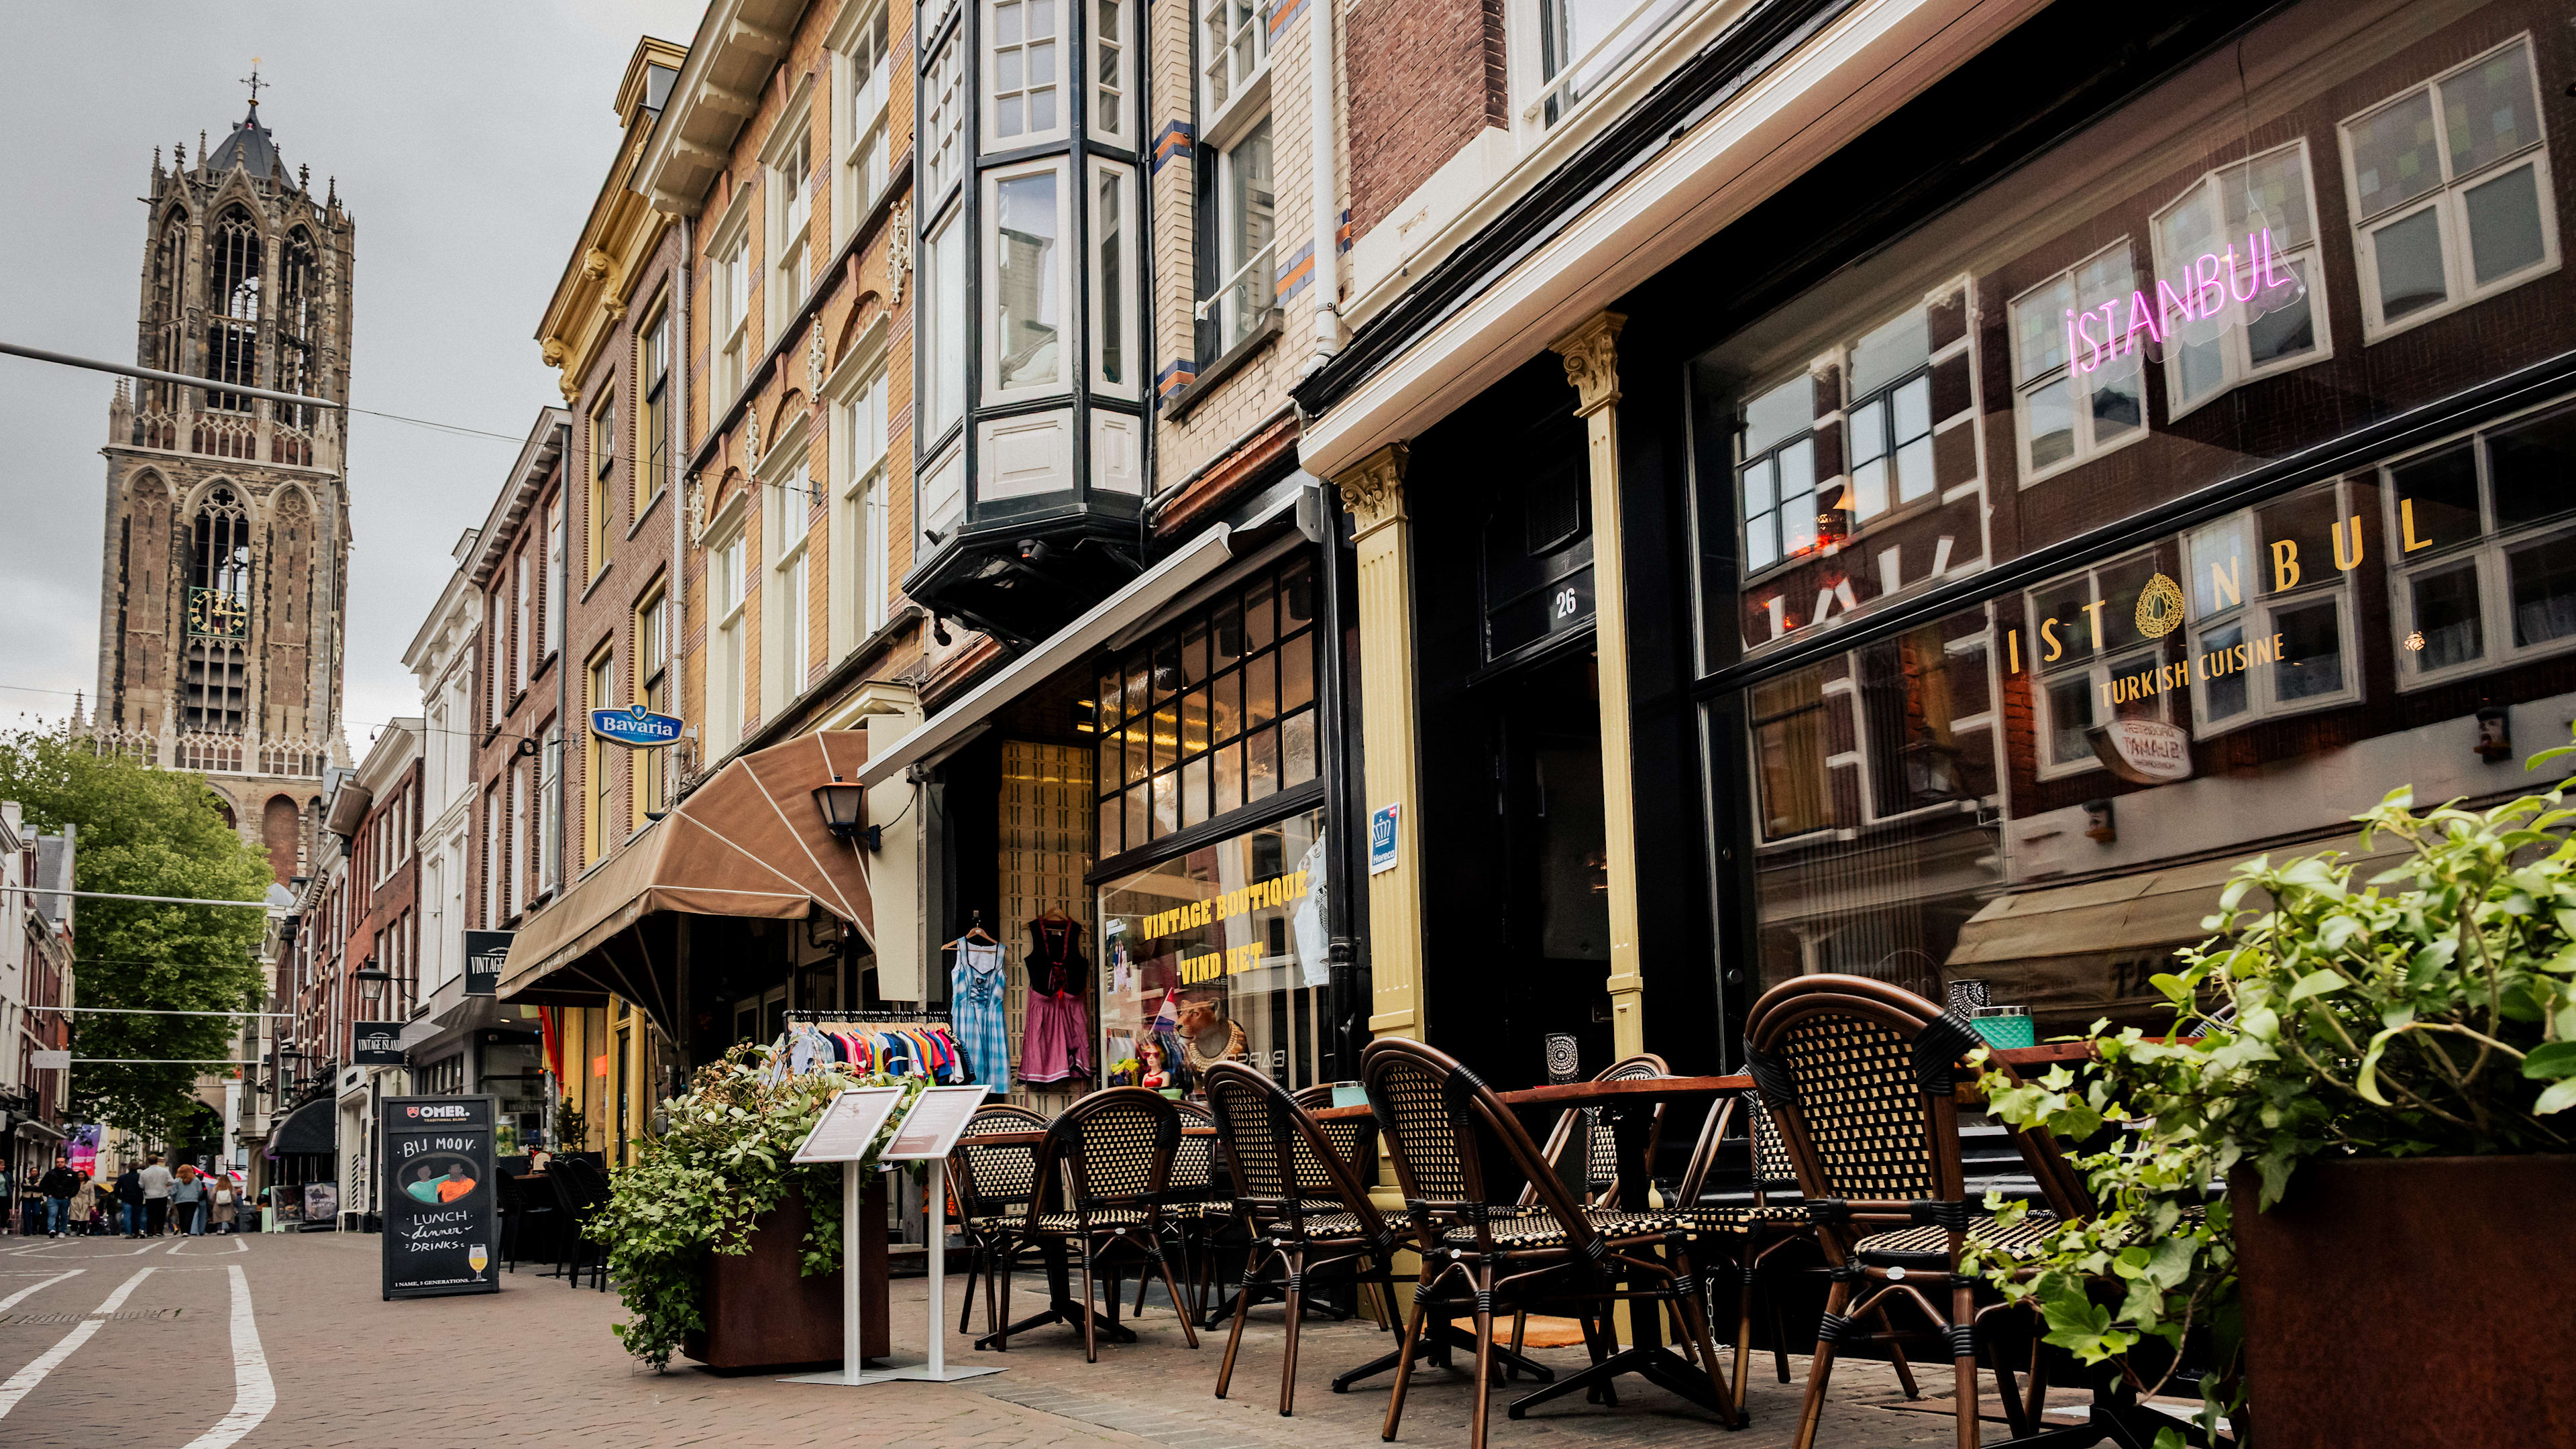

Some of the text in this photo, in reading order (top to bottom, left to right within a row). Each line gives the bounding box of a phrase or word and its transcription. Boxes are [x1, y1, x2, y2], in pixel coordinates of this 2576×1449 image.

[1556, 587, 1576, 619] 26
[2099, 633, 2285, 708] TURKISH CUISINE
[602, 716, 674, 737] Bavaria
[1373, 849, 1395, 865] Horeca
[1143, 899, 1211, 940] VINTAGE
[1216, 870, 1308, 921] BOUTIQUE
[470, 956, 504, 975] VINTAGE
[1180, 941, 1263, 985] VIND HET
[358, 1038, 381, 1051] VINTAGE
[420, 1106, 470, 1118] OMER.
[403, 1138, 428, 1158] BIJ
[413, 1210, 467, 1226] LUNCH
[411, 1225, 463, 1239] dinner
